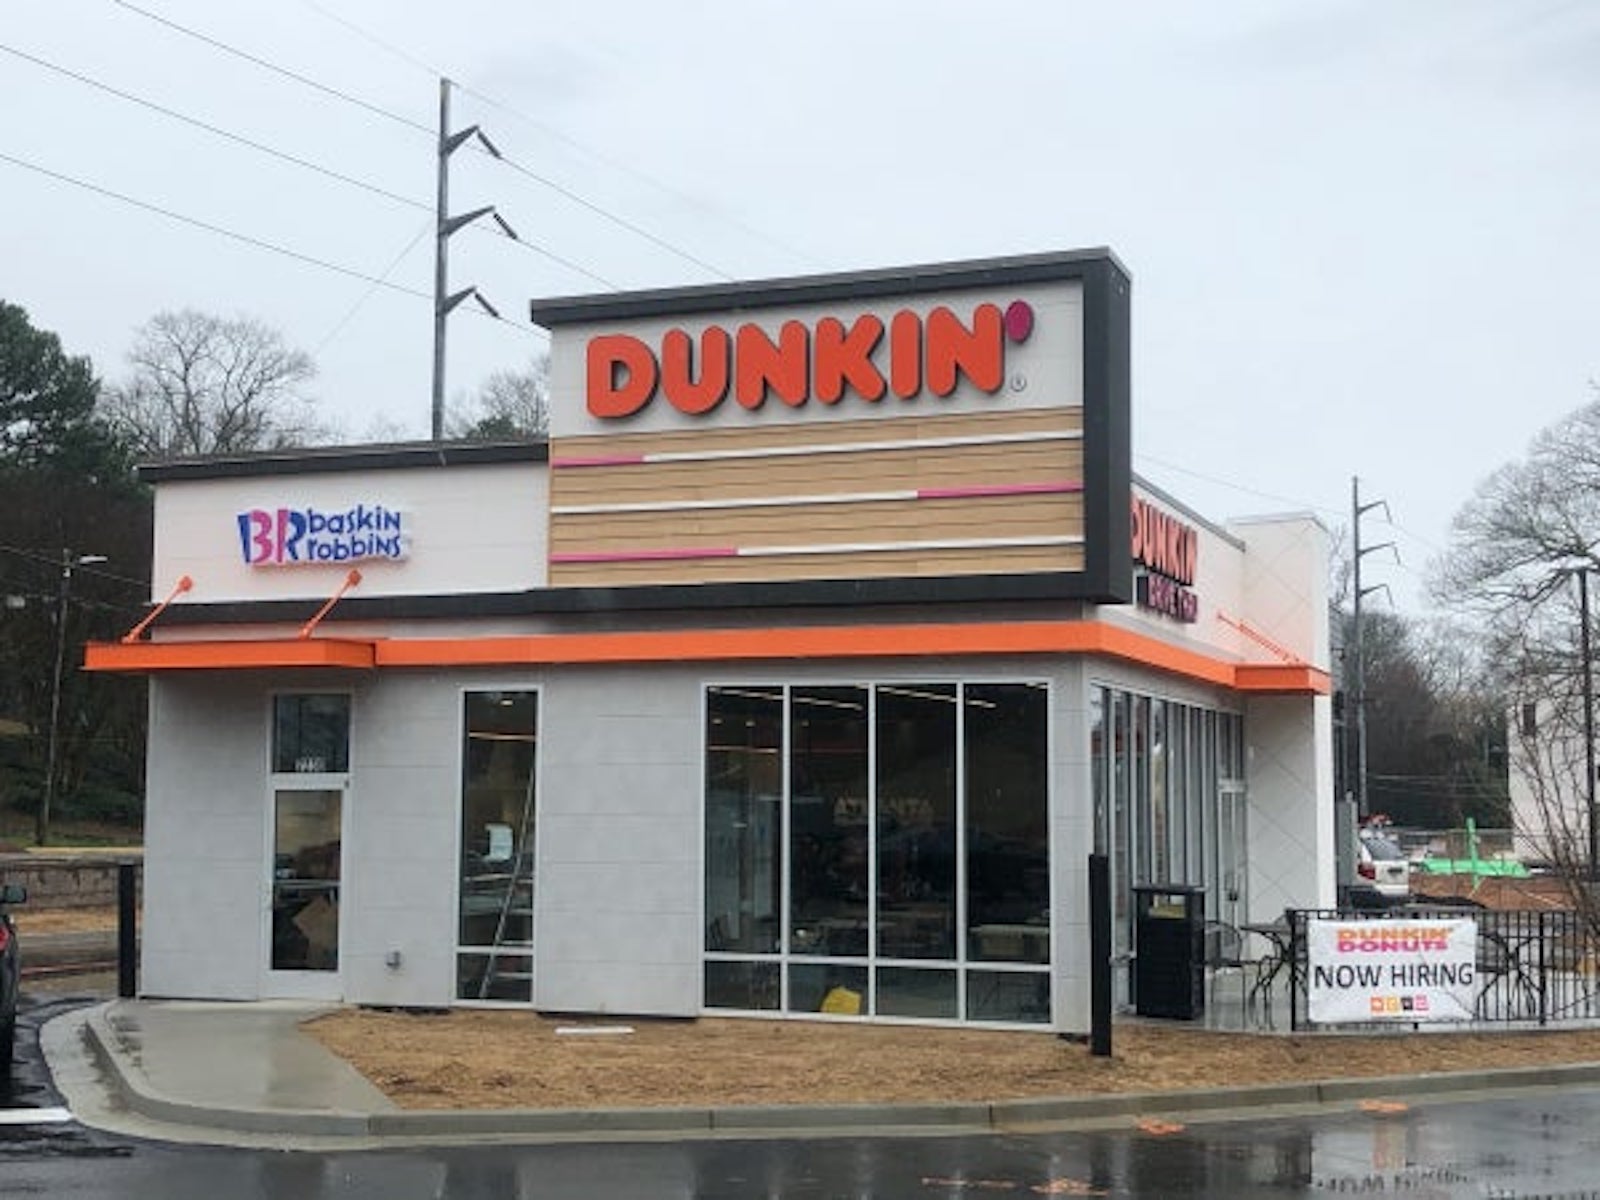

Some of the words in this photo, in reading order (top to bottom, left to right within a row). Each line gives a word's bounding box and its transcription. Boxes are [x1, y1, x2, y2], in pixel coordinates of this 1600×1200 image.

[586, 300, 1034, 419] DUNKIN'
[307, 504, 401, 534] baskin
[237, 508, 307, 563] BR
[306, 534, 401, 561] robbins
[1337, 940, 1449, 953] DONUTS
[1314, 964, 1382, 989] NOW
[1391, 962, 1474, 988] HIRING
